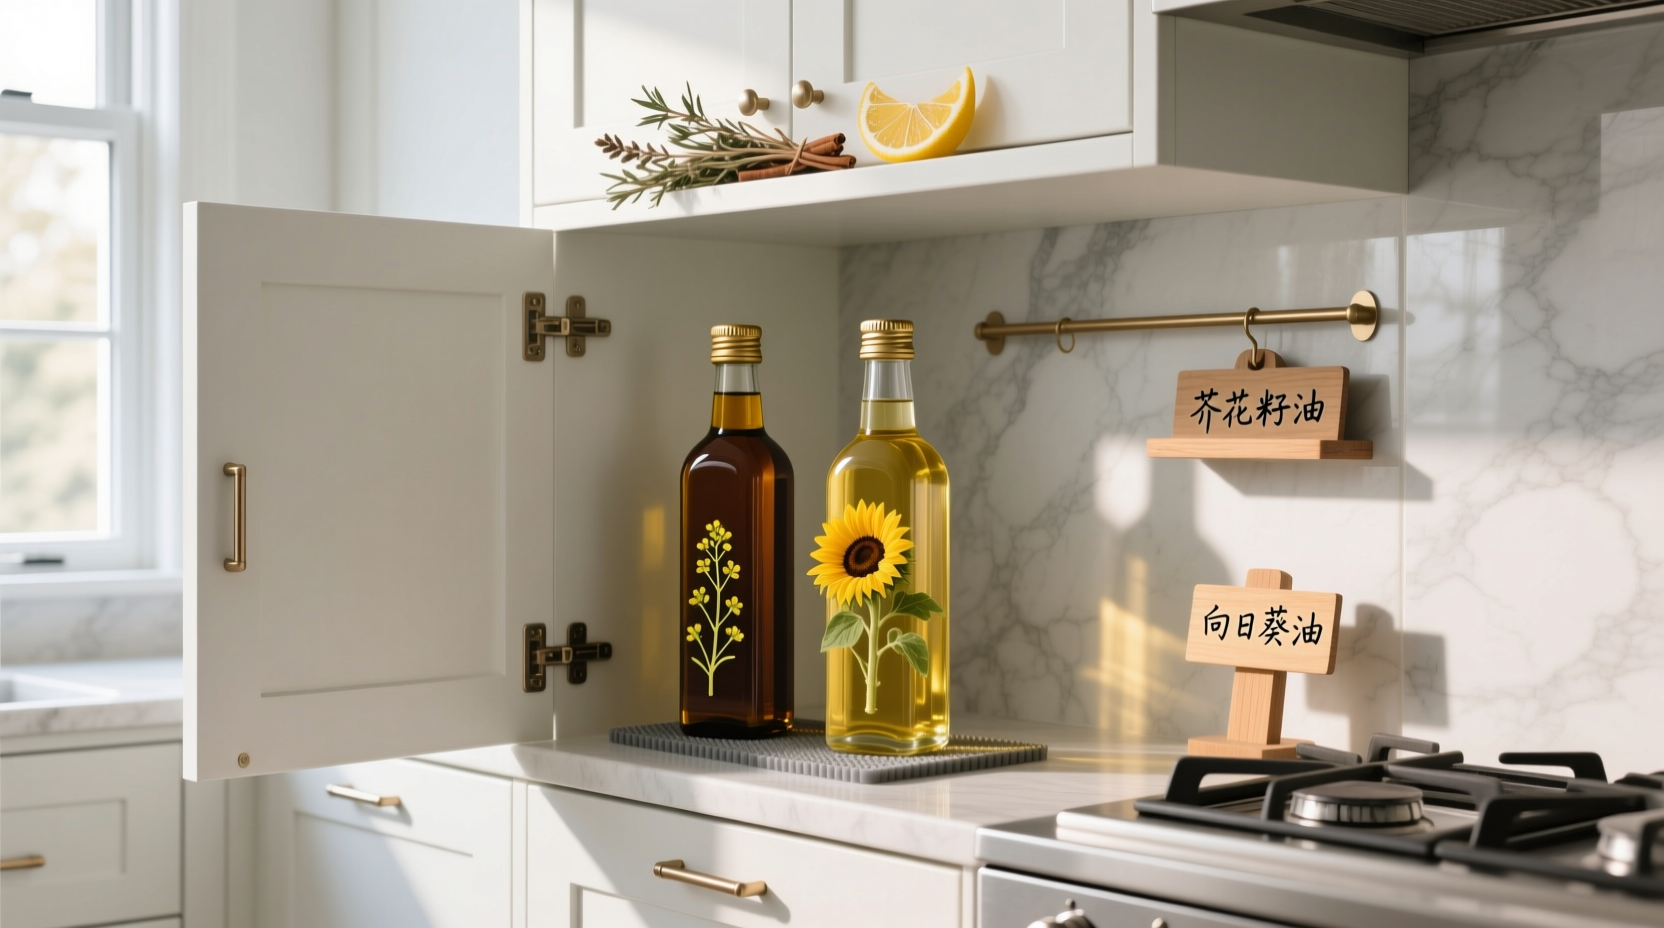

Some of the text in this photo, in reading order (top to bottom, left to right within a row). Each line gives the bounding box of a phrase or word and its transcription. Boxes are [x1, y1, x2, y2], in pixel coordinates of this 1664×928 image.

[1190, 388, 1324, 434] 芥花籽油
[1204, 604, 1323, 646] 向日葵油
